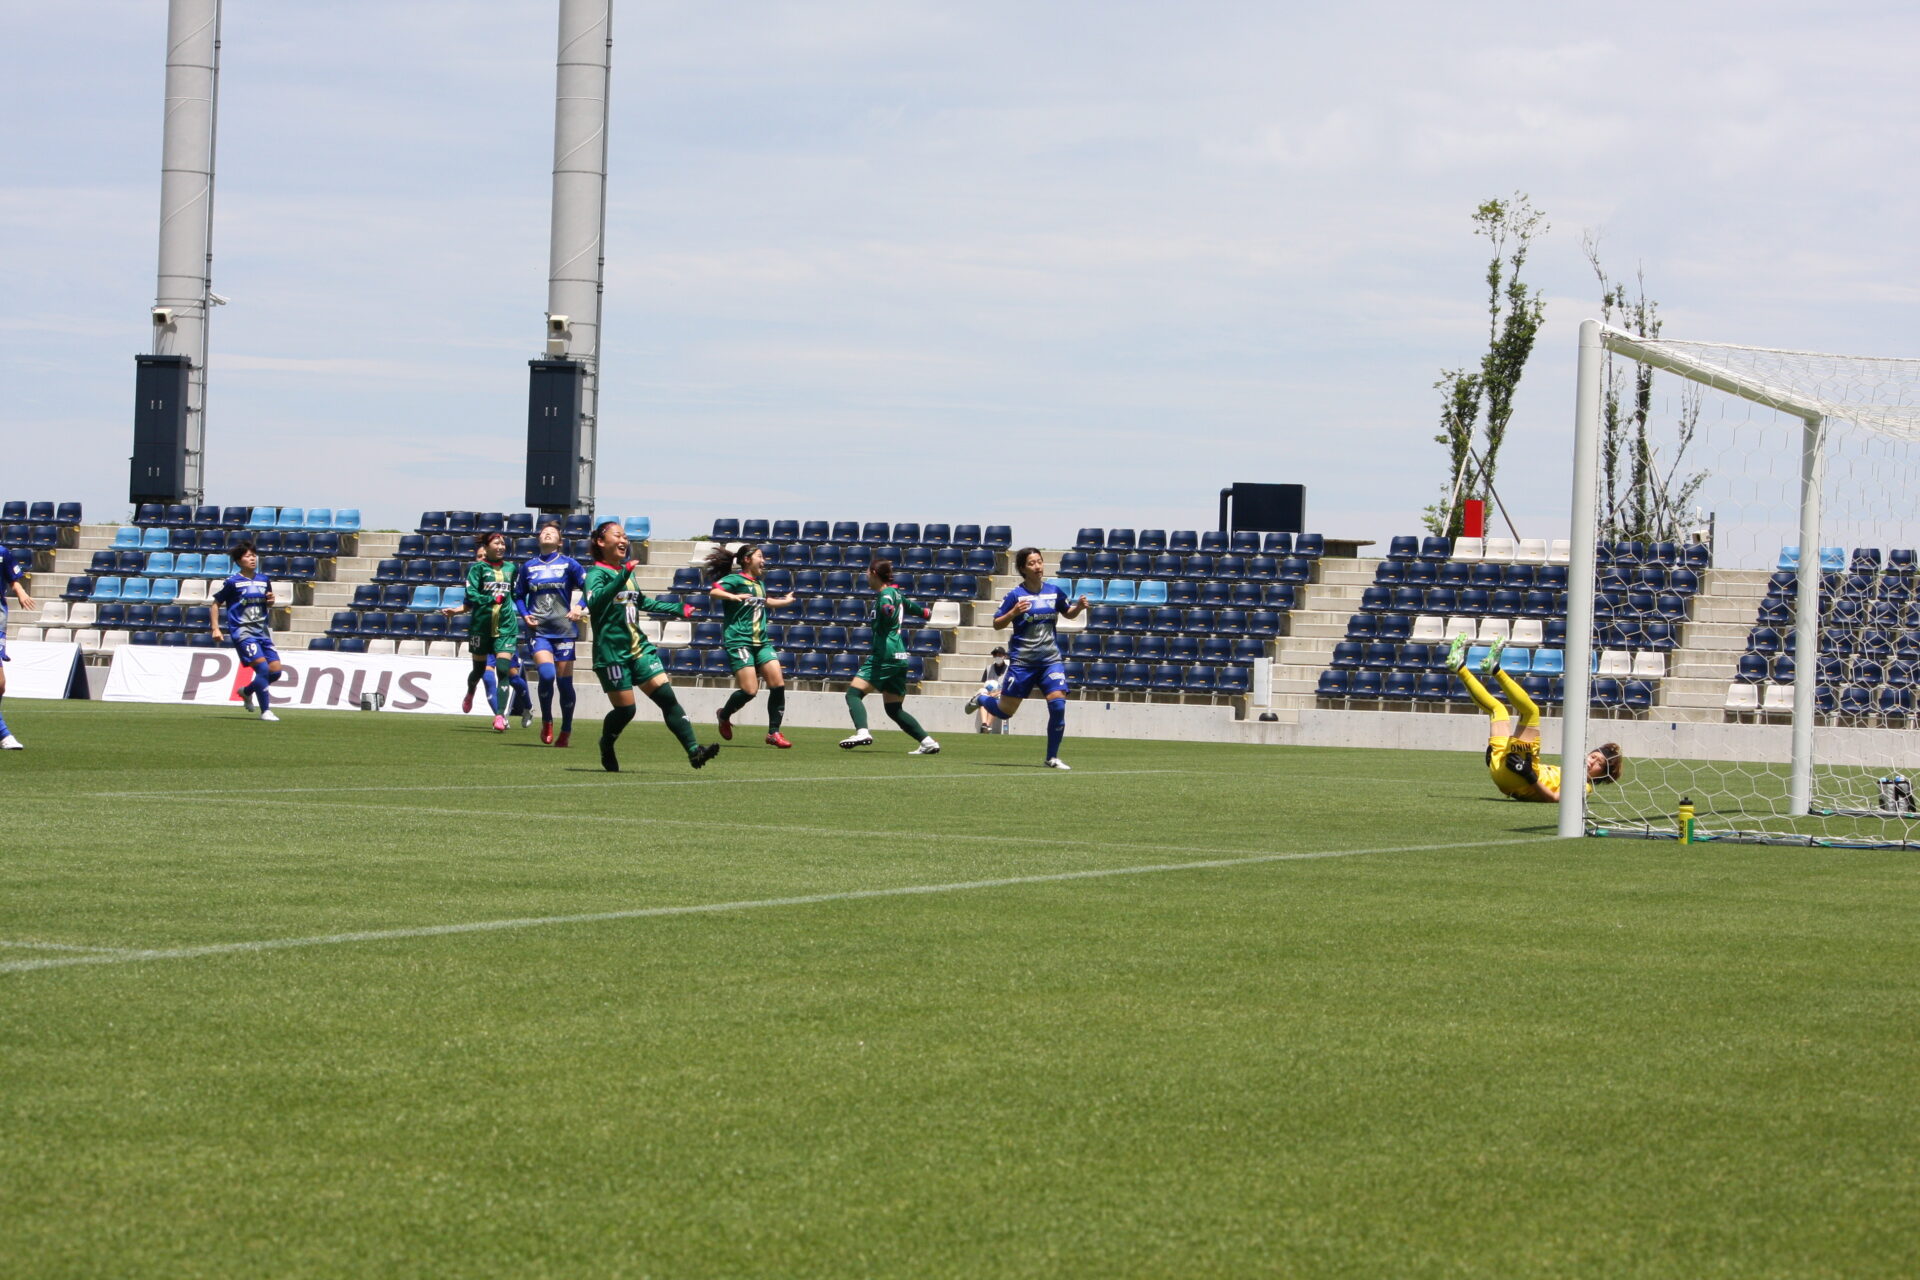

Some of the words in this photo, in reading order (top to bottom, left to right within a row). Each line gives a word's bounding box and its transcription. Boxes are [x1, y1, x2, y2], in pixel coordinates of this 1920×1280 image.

[626, 605, 637, 624] 10
[246, 643, 258, 657] 19
[607, 665, 622, 680] 10
[1007, 676, 1015, 691] 7
